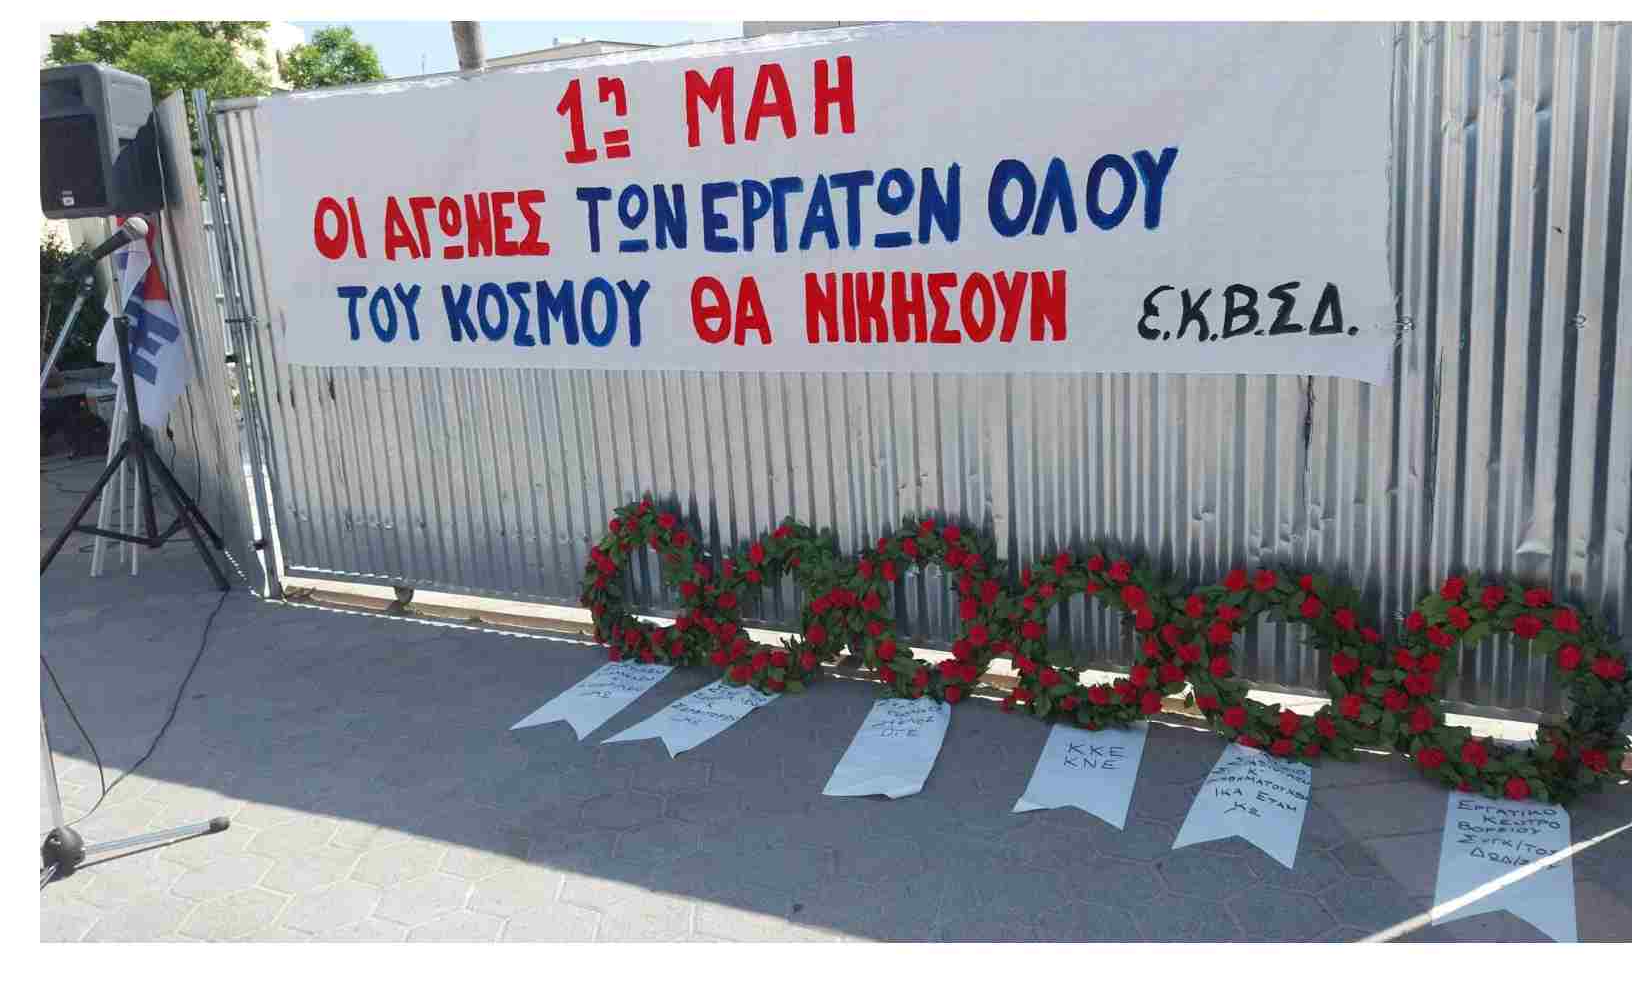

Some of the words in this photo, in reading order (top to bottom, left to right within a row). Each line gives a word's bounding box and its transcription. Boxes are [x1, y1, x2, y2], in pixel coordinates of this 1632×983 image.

[684, 55, 857, 148] ΜΑΗ
[313, 196, 368, 261] ΟΙ
[384, 189, 550, 261] ΑΓΩΝΕΣ
[576, 183, 688, 254] ΤΩΝ
[701, 162, 961, 254] ΕΡΓΑΤΩΝ
[987, 146, 1179, 238] ΟΛΟΥ
[337, 281, 422, 344] ΤΟΥ
[440, 276, 651, 348] ΚΟΣΜΟΥ
[690, 275, 773, 347] ΘΑ
[804, 269, 1068, 345] ΝΙΚΗΣΟΥΝ
[1063, 756, 1121, 771] ΚΝΕ
[1067, 741, 1127, 758] ΚΚΕ
